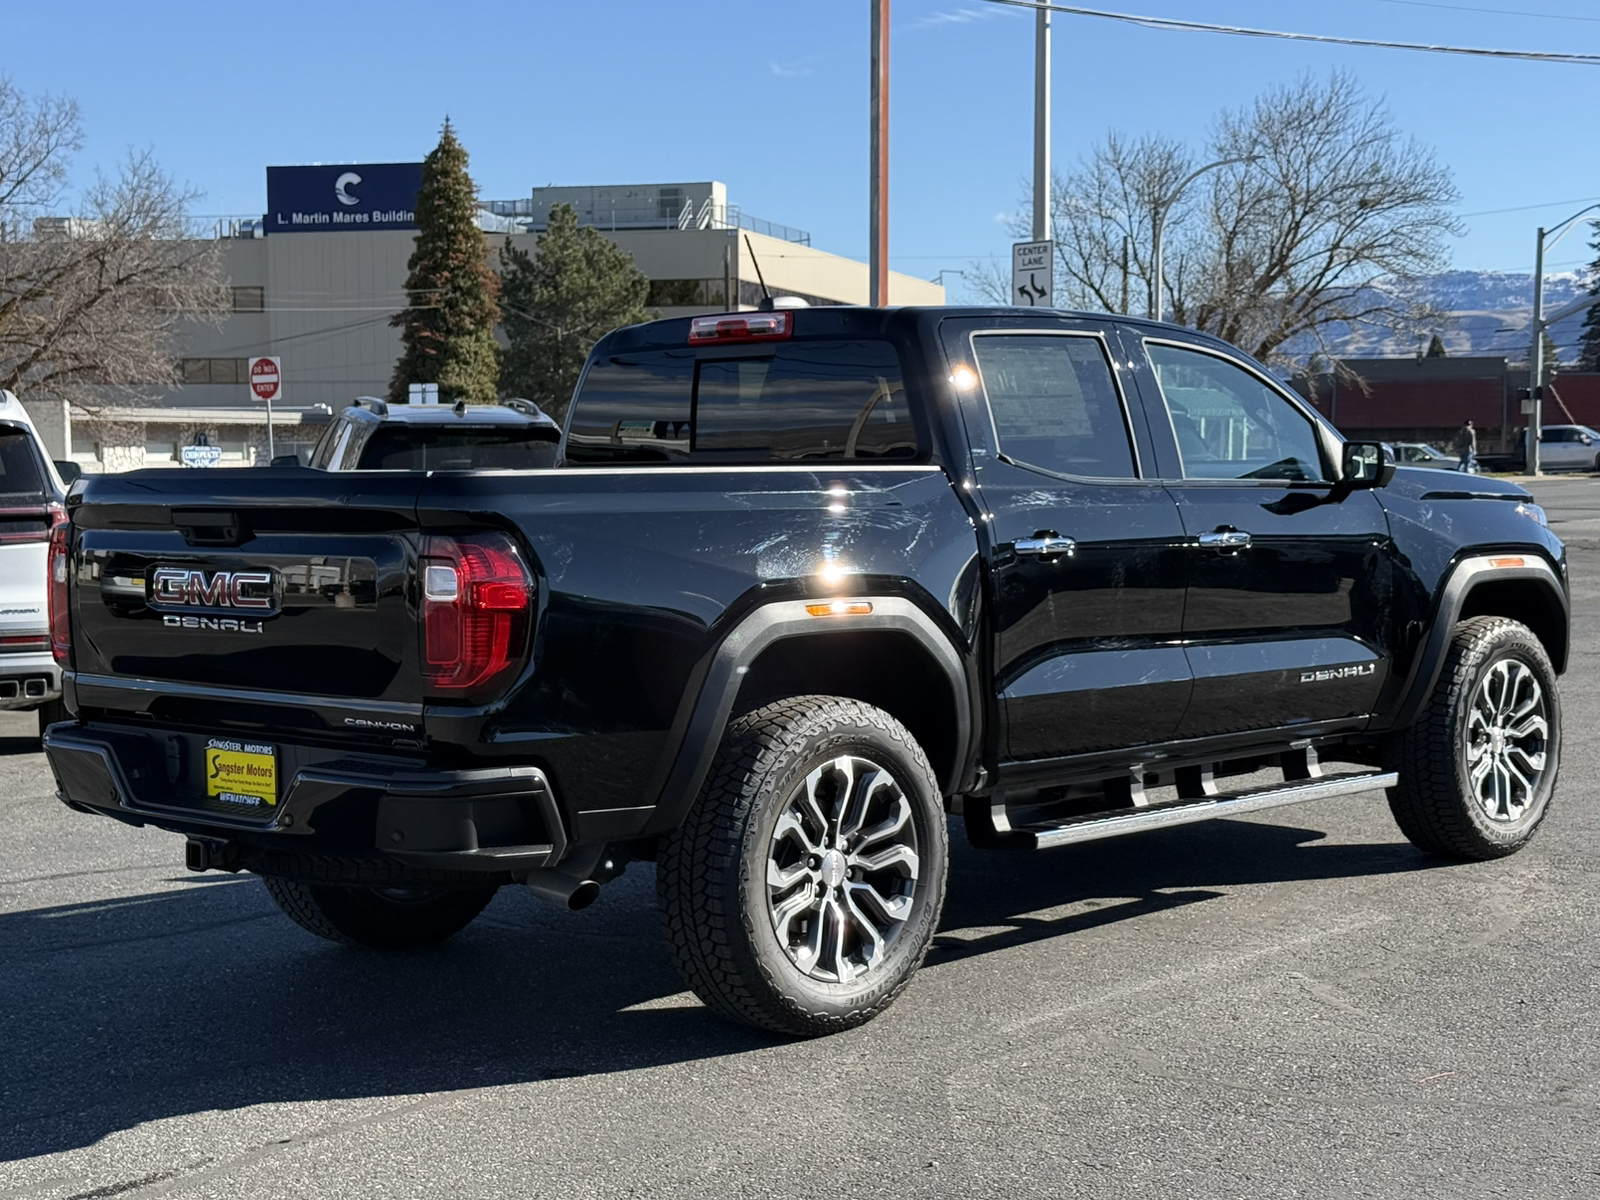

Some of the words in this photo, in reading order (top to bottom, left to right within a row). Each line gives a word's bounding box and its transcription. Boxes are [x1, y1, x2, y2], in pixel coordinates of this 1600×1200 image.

[277, 213, 289, 225] L.
[292, 212, 329, 224] Martin
[333, 211, 369, 224] Mares
[372, 210, 415, 223] Buildin
[1017, 246, 1048, 257] CENTER
[1022, 256, 1044, 267] LANE
[253, 365, 262, 374] DO
[263, 364, 275, 373] NOT
[256, 383, 275, 393] ENTER
[153, 569, 271, 609] GMC
[163, 614, 264, 634] DENALI
[1300, 663, 1376, 683] DENALI
[344, 717, 415, 733] CANYON
[204, 738, 243, 752] SANGSTER
[244, 743, 273, 755] MOTORS
[210, 754, 245, 779] Sangster
[246, 763, 273, 778] Motors
